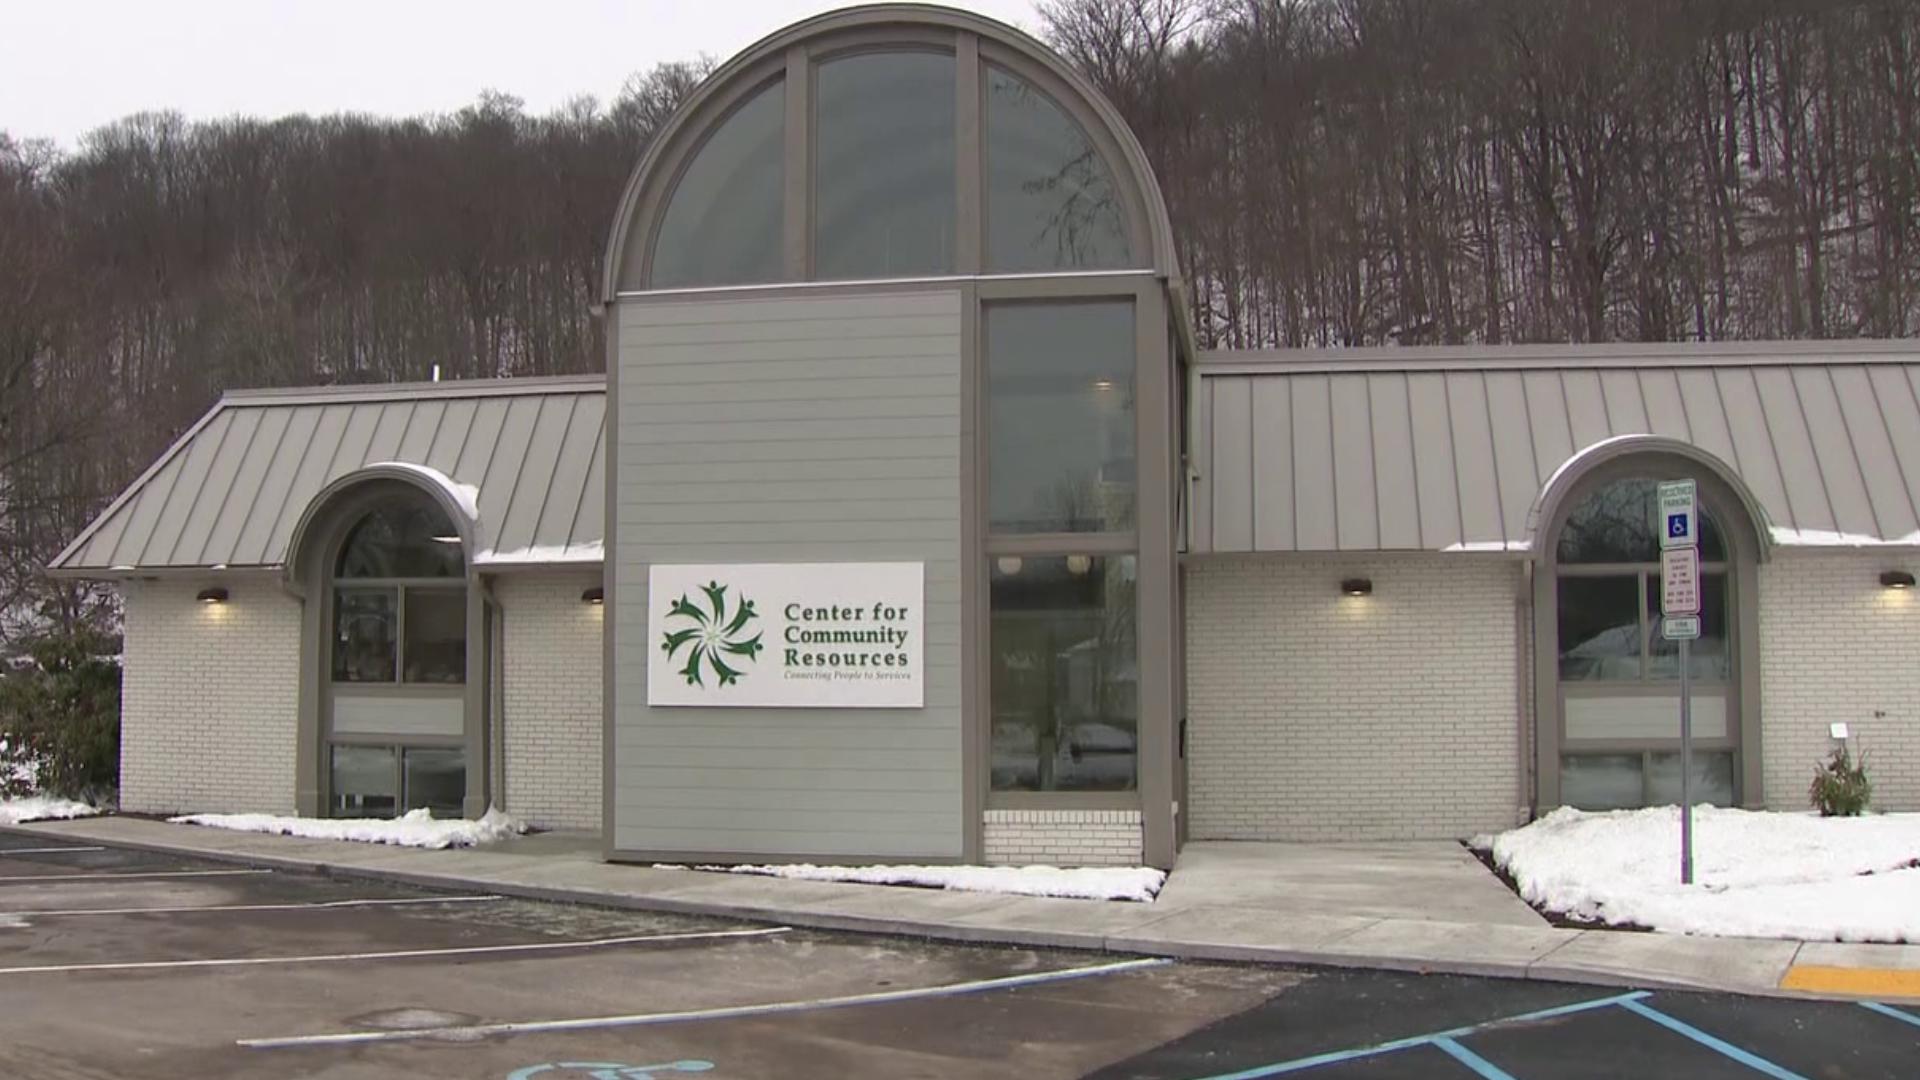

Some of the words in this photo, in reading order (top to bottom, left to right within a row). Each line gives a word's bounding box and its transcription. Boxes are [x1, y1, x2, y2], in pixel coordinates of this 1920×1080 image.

[784, 603, 864, 621] Center
[873, 602, 908, 621] for
[784, 625, 908, 649] Community
[784, 648, 908, 667] Resources
[784, 670, 832, 680] Connecting
[834, 671, 862, 680] People
[864, 671, 874, 679] to
[876, 671, 911, 680] Services
